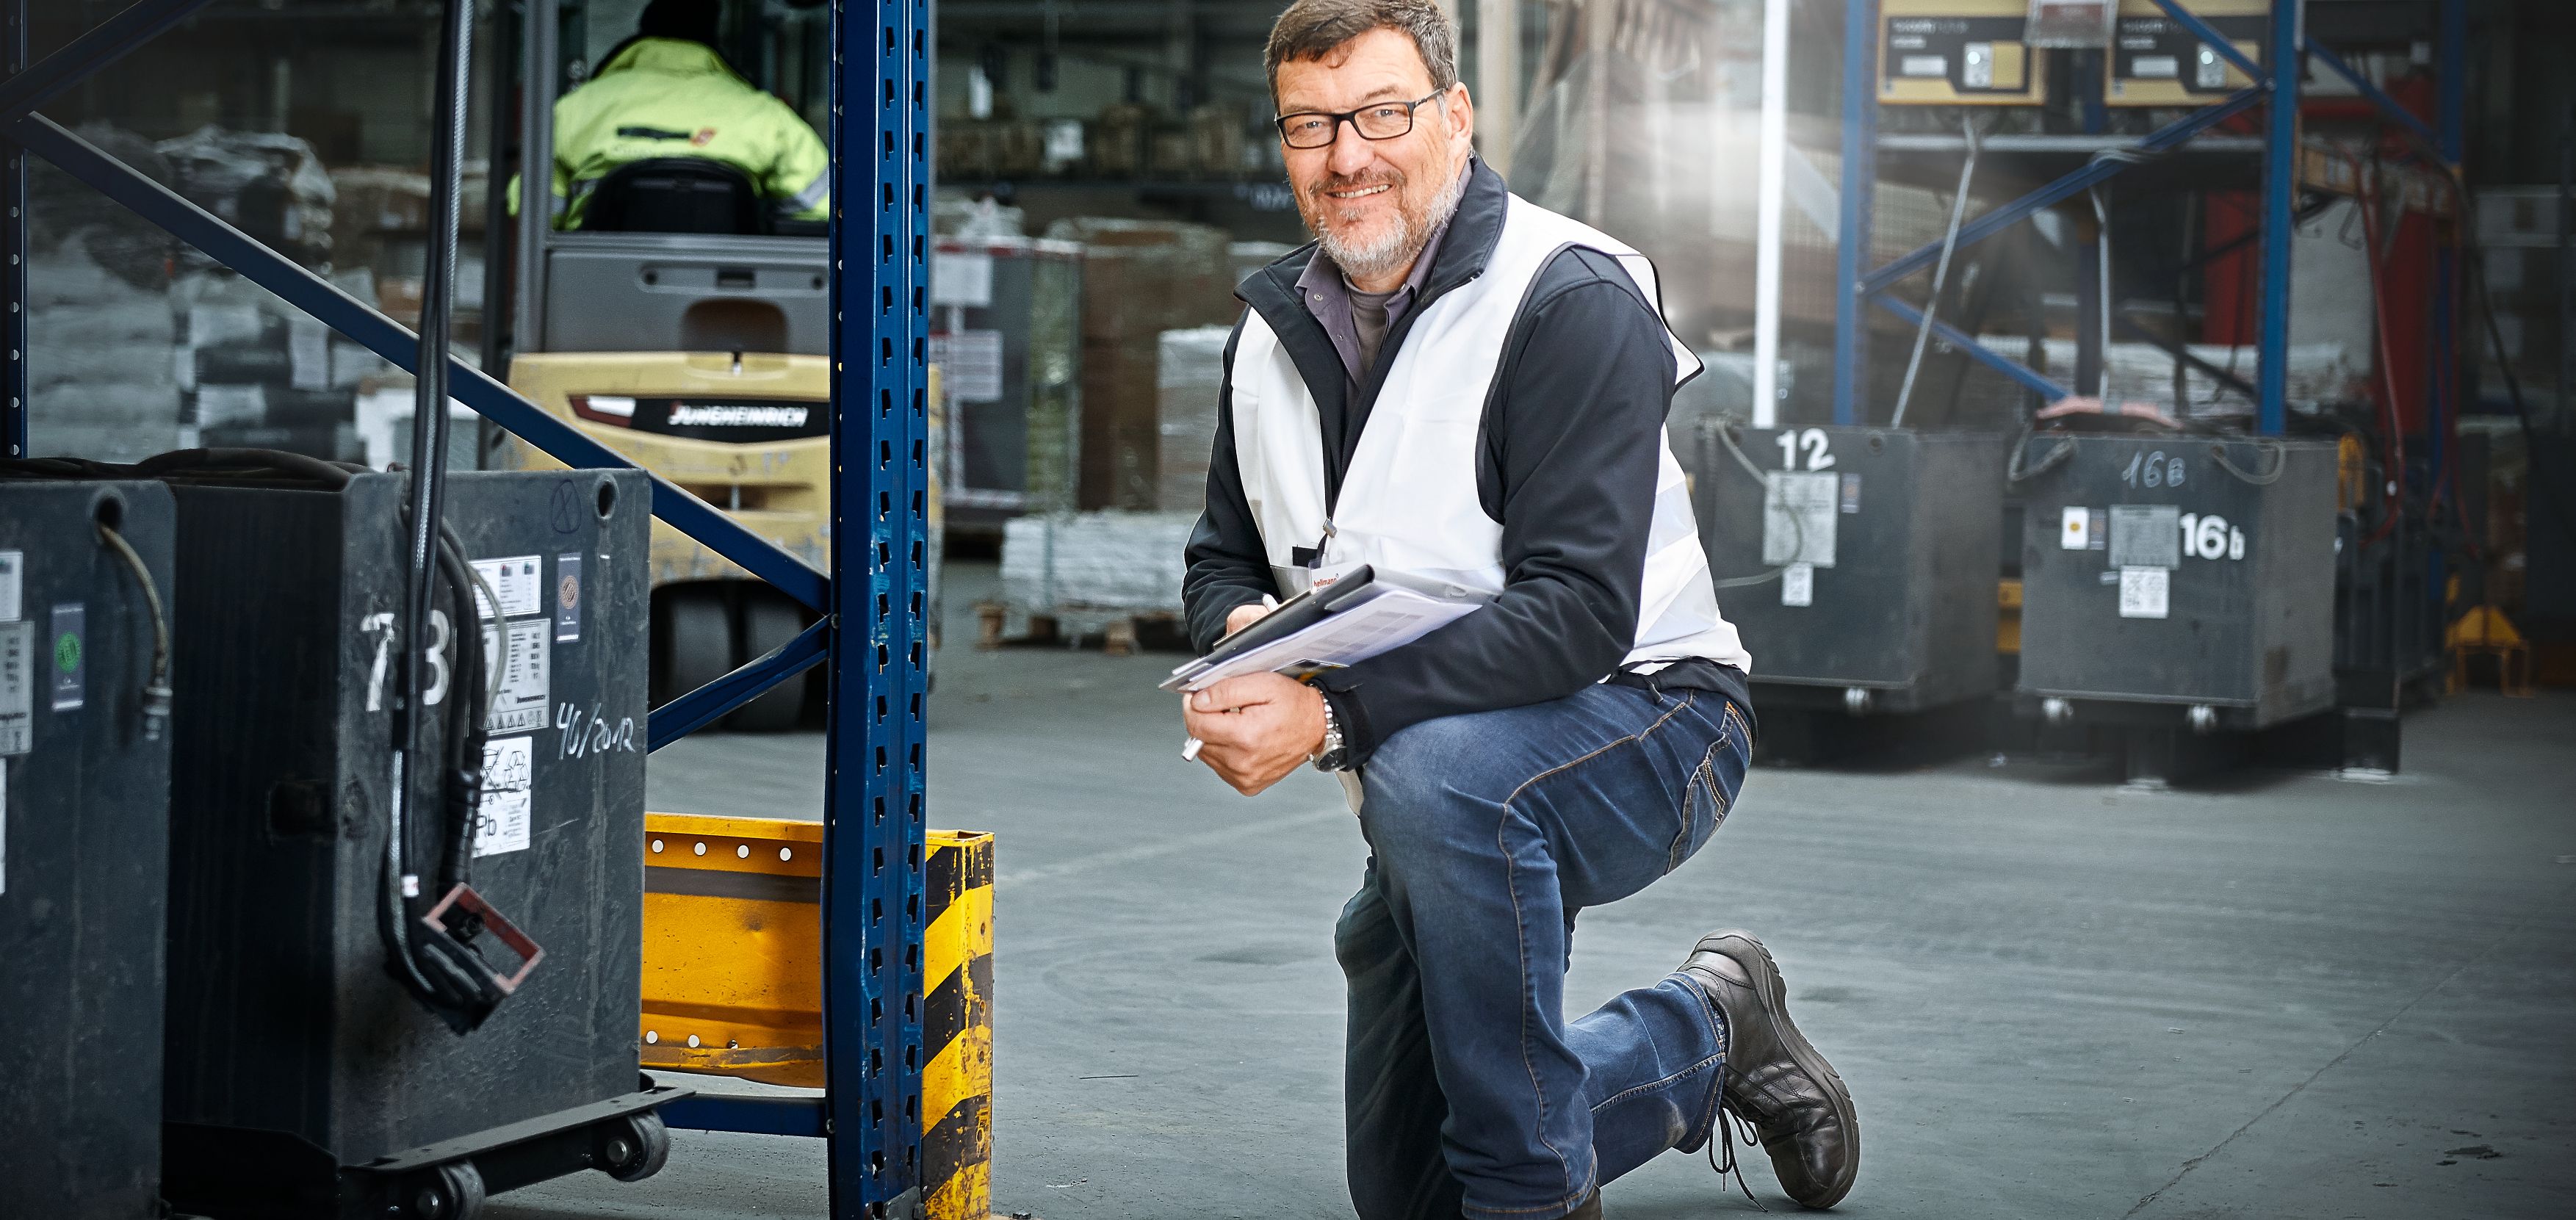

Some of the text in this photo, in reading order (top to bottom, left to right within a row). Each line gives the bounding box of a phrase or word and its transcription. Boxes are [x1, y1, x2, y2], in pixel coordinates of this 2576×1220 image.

[667, 403, 808, 427] JUNGHEINRICH
[1775, 428, 1836, 472] 12
[2179, 512, 2246, 560] 16b
